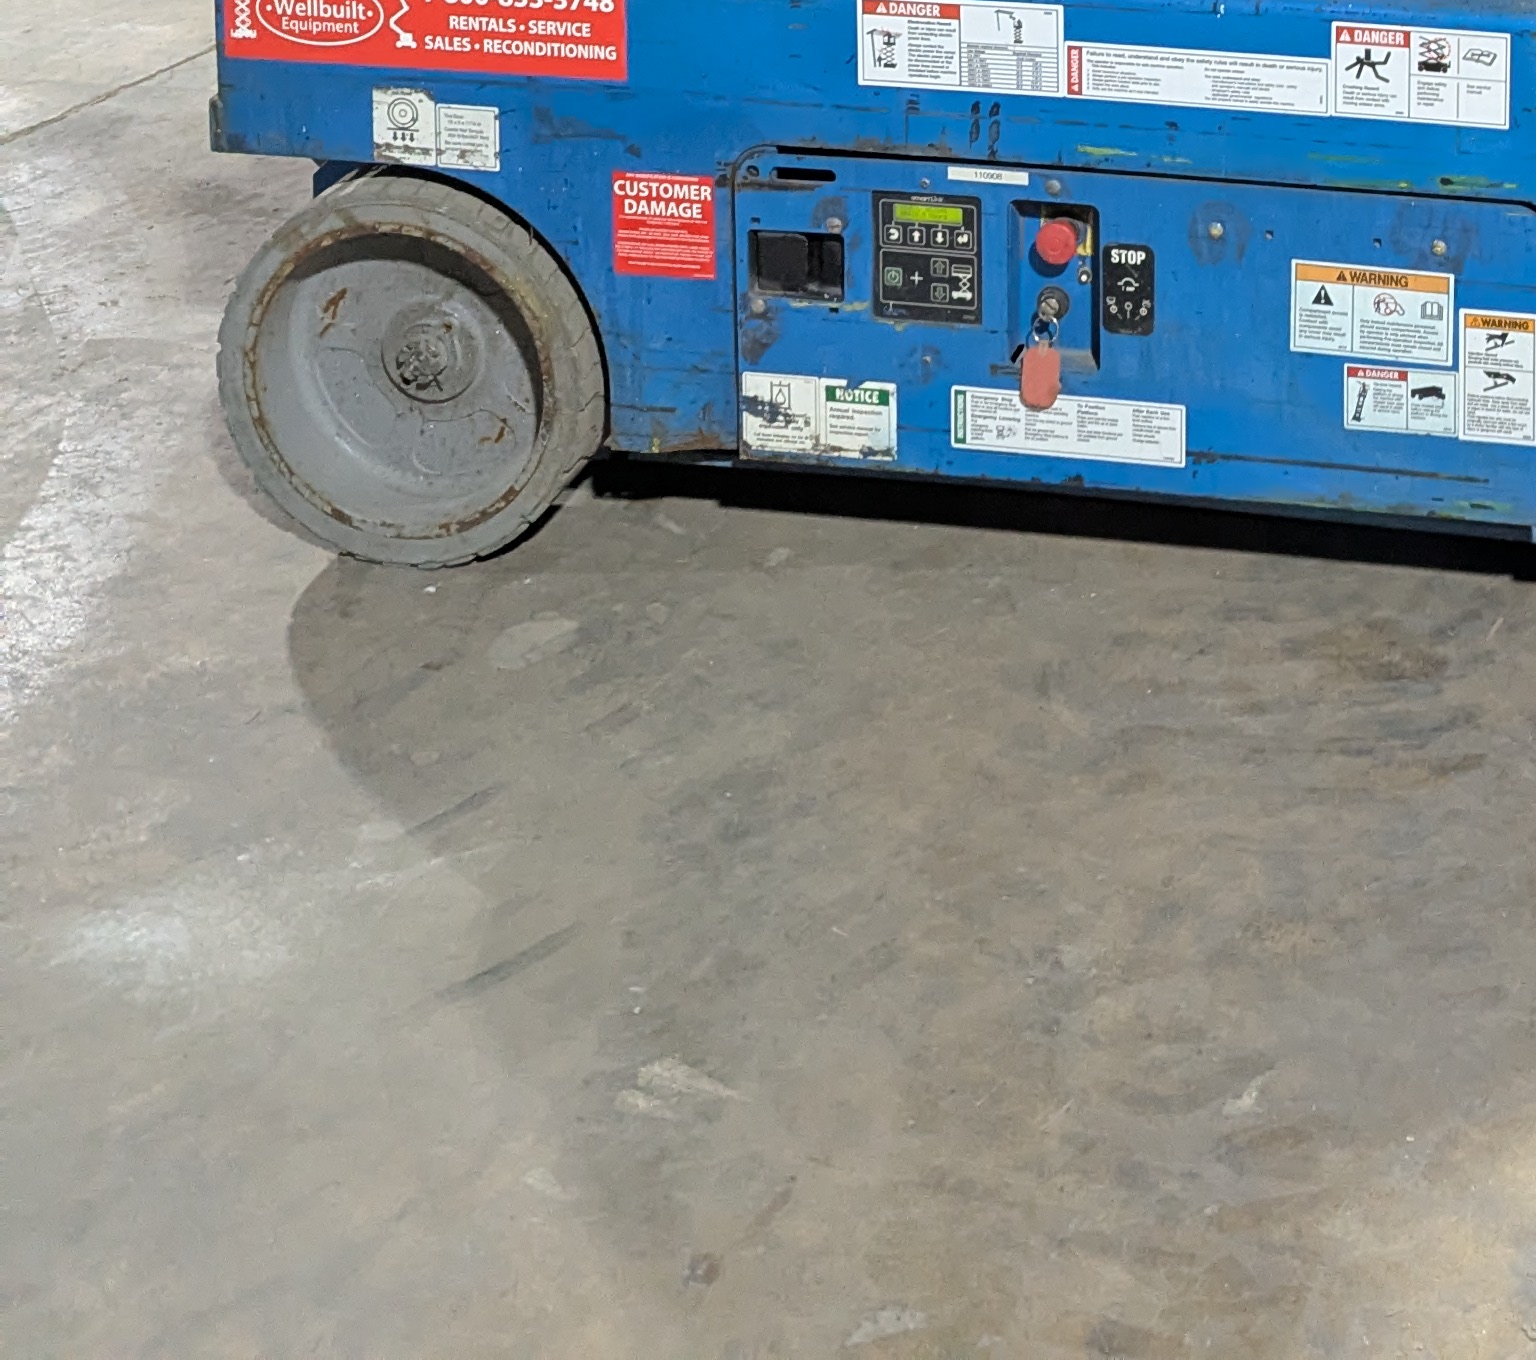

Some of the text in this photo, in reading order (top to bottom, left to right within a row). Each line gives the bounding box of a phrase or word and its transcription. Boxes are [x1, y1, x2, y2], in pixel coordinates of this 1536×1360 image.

[889, 4, 940, 17] DANGER
[281, 16, 359, 35] Equipment
[449, 15, 591, 38] RENTALS SERVICE
[1354, 29, 1404, 45] DANGER
[424, 36, 617, 60] SALES RECONDITIONING
[1070, 48, 1079, 83] DANGER
[974, 171, 1003, 180] 110908
[614, 180, 712, 201] CUSTOMER
[624, 199, 702, 218] DAMAGE
[1111, 249, 1146, 265] STOP
[1349, 271, 1408, 287] WARNING
[1481, 318, 1530, 330] WARNING
[1366, 371, 1399, 380] DANGER
[836, 388, 879, 404] NOTICE
